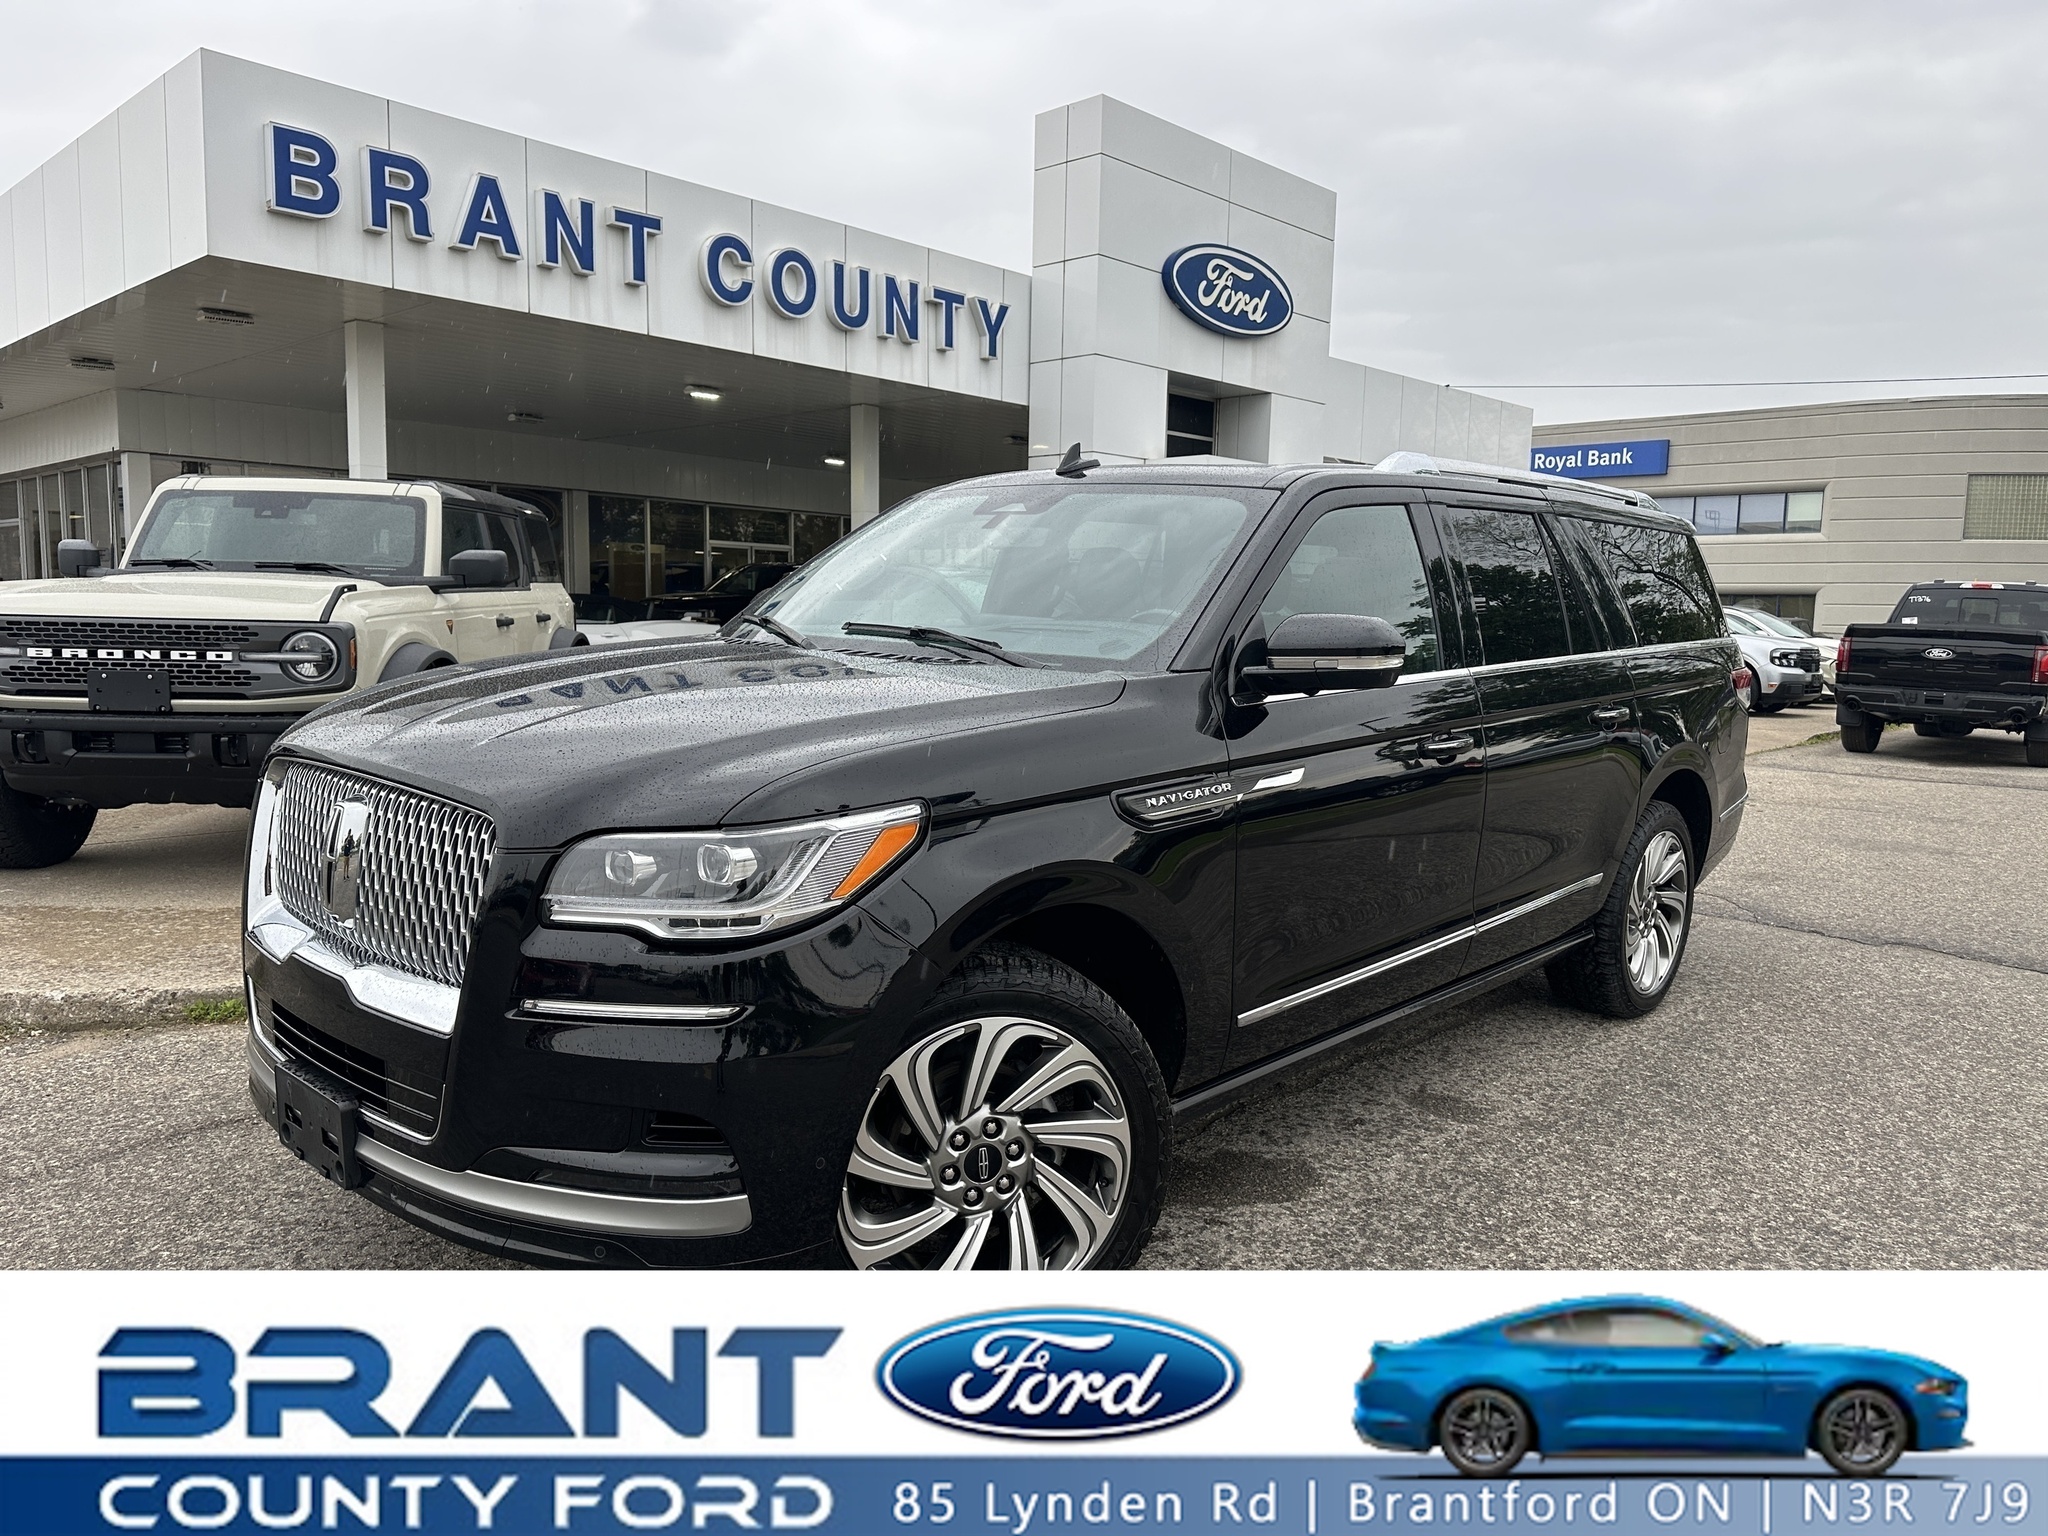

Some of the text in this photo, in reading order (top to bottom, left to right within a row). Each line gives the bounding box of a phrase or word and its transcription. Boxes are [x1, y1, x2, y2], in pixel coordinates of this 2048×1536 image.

[265, 122, 1010, 360] BRANT COUNTY
[1198, 258, 1270, 323] Ford
[1534, 447, 1633, 472] Royal Bank
[26, 647, 233, 661] BRONCO
[1145, 782, 1232, 808] NAVIGATOR
